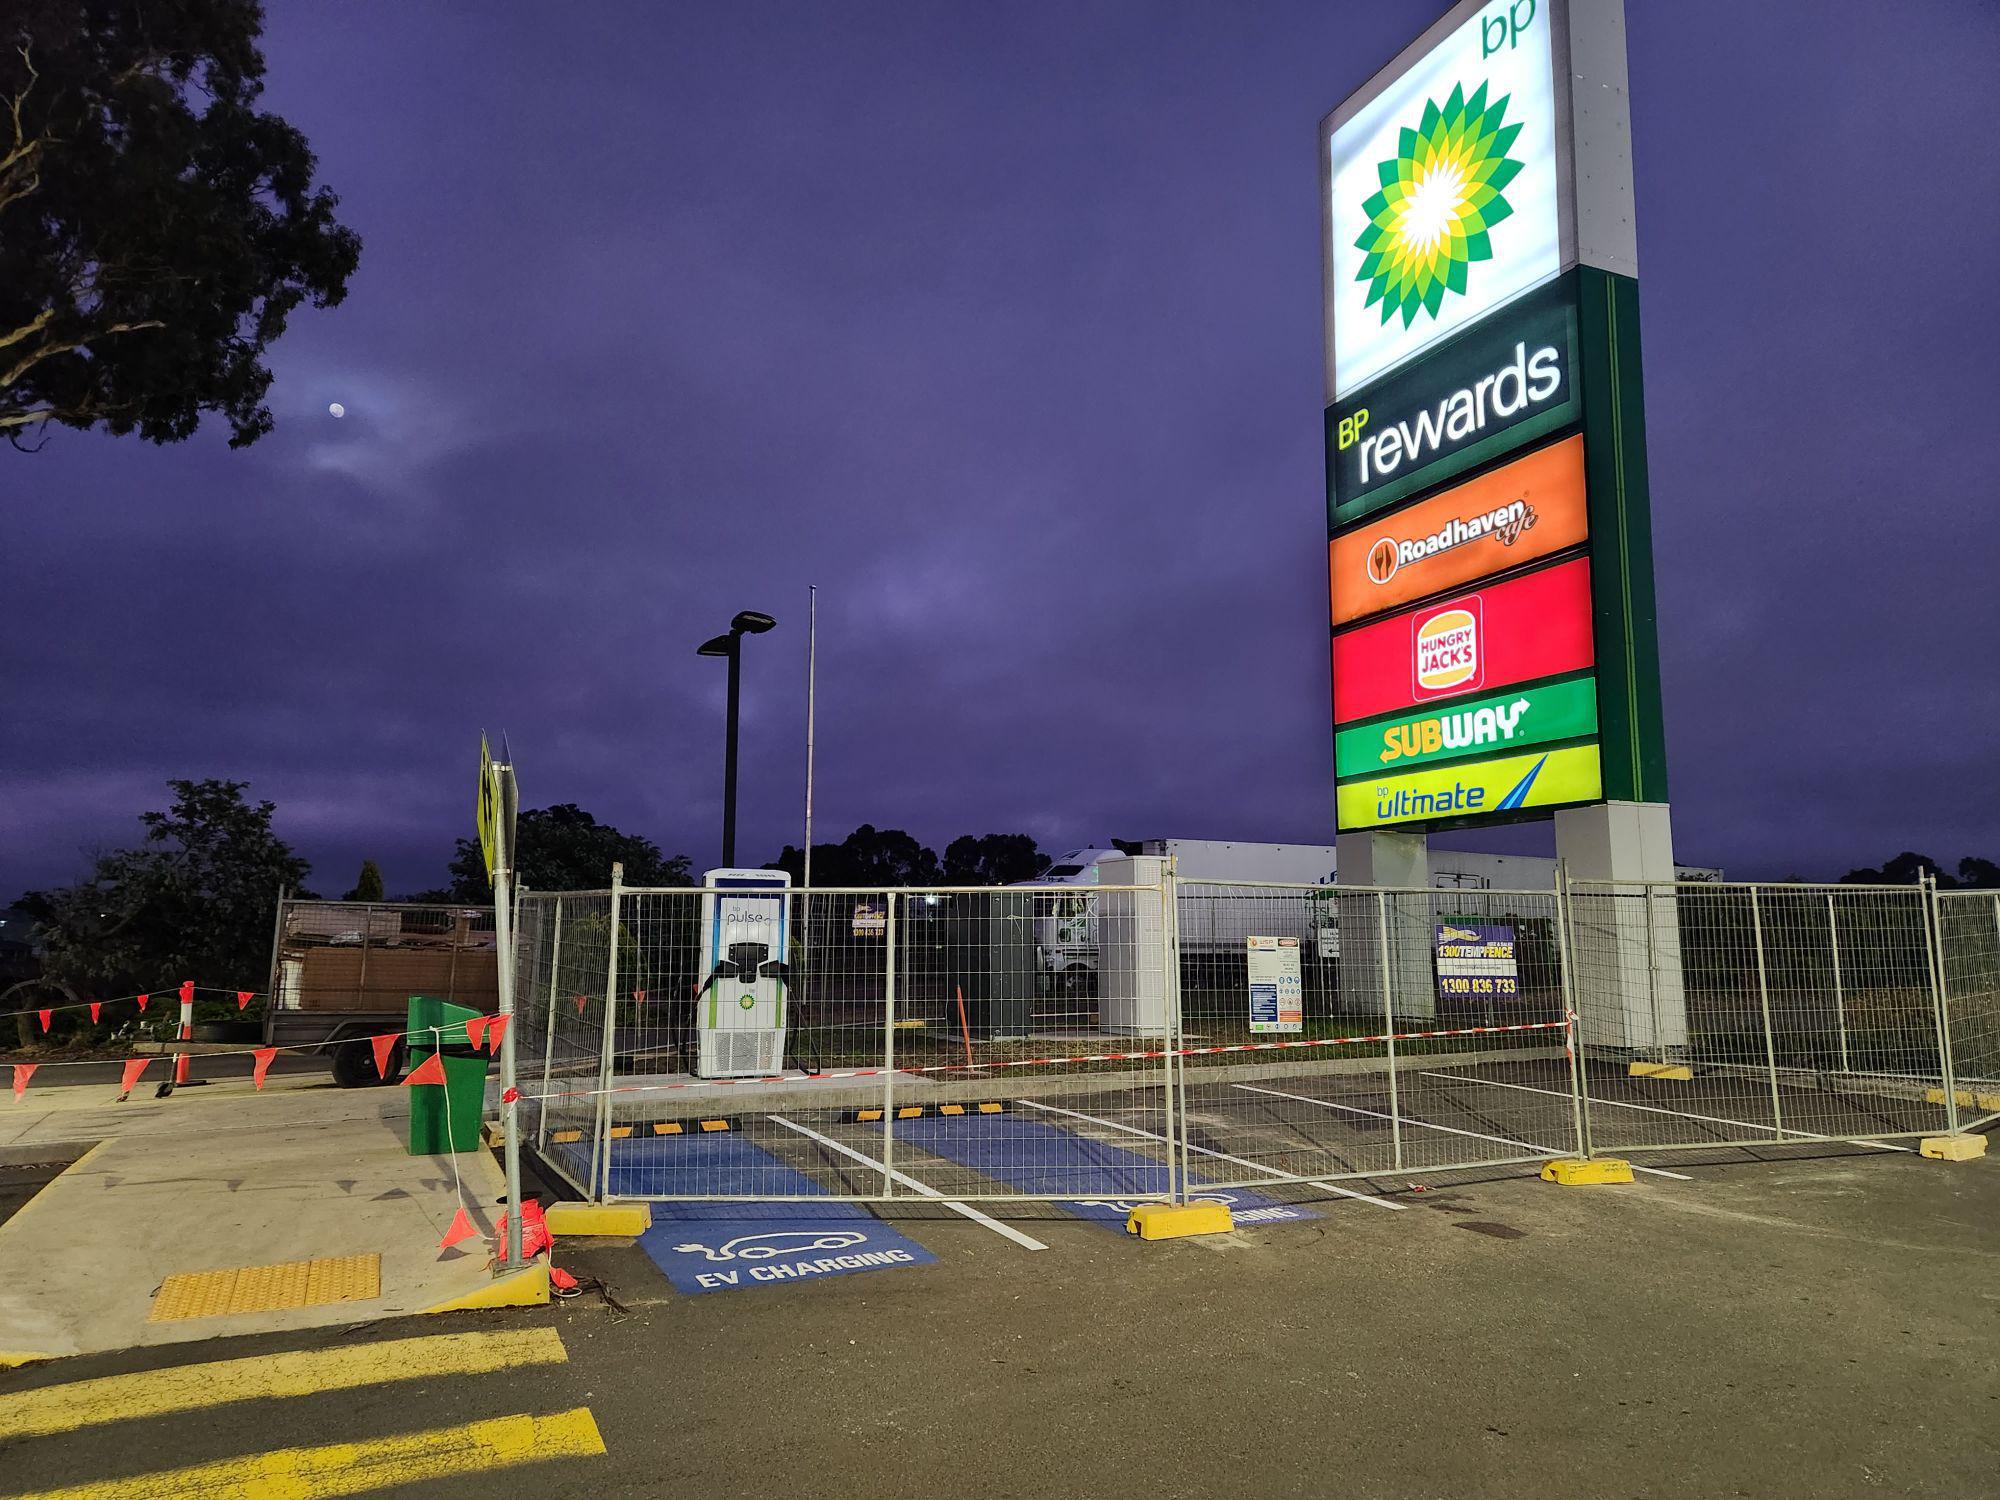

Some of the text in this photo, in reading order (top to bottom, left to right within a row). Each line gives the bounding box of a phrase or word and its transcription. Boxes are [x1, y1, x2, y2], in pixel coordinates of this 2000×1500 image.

[1482, 0, 1536, 60] bp
[1338, 408, 1369, 451] BP
[1358, 342, 1562, 484] rewards
[1399, 499, 1525, 562] Roadhaven
[1421, 629, 1472, 654] HUNGRY
[1421, 644, 1473, 674] JACK'S
[1379, 698, 1531, 763] SUBWAY
[1377, 785, 1389, 798] bp
[1377, 782, 1485, 819] ultimate
[727, 910, 763, 926] pulse
[1442, 978, 1516, 994] 1300 836 733
[695, 1249, 914, 1288] EV CHARGING
